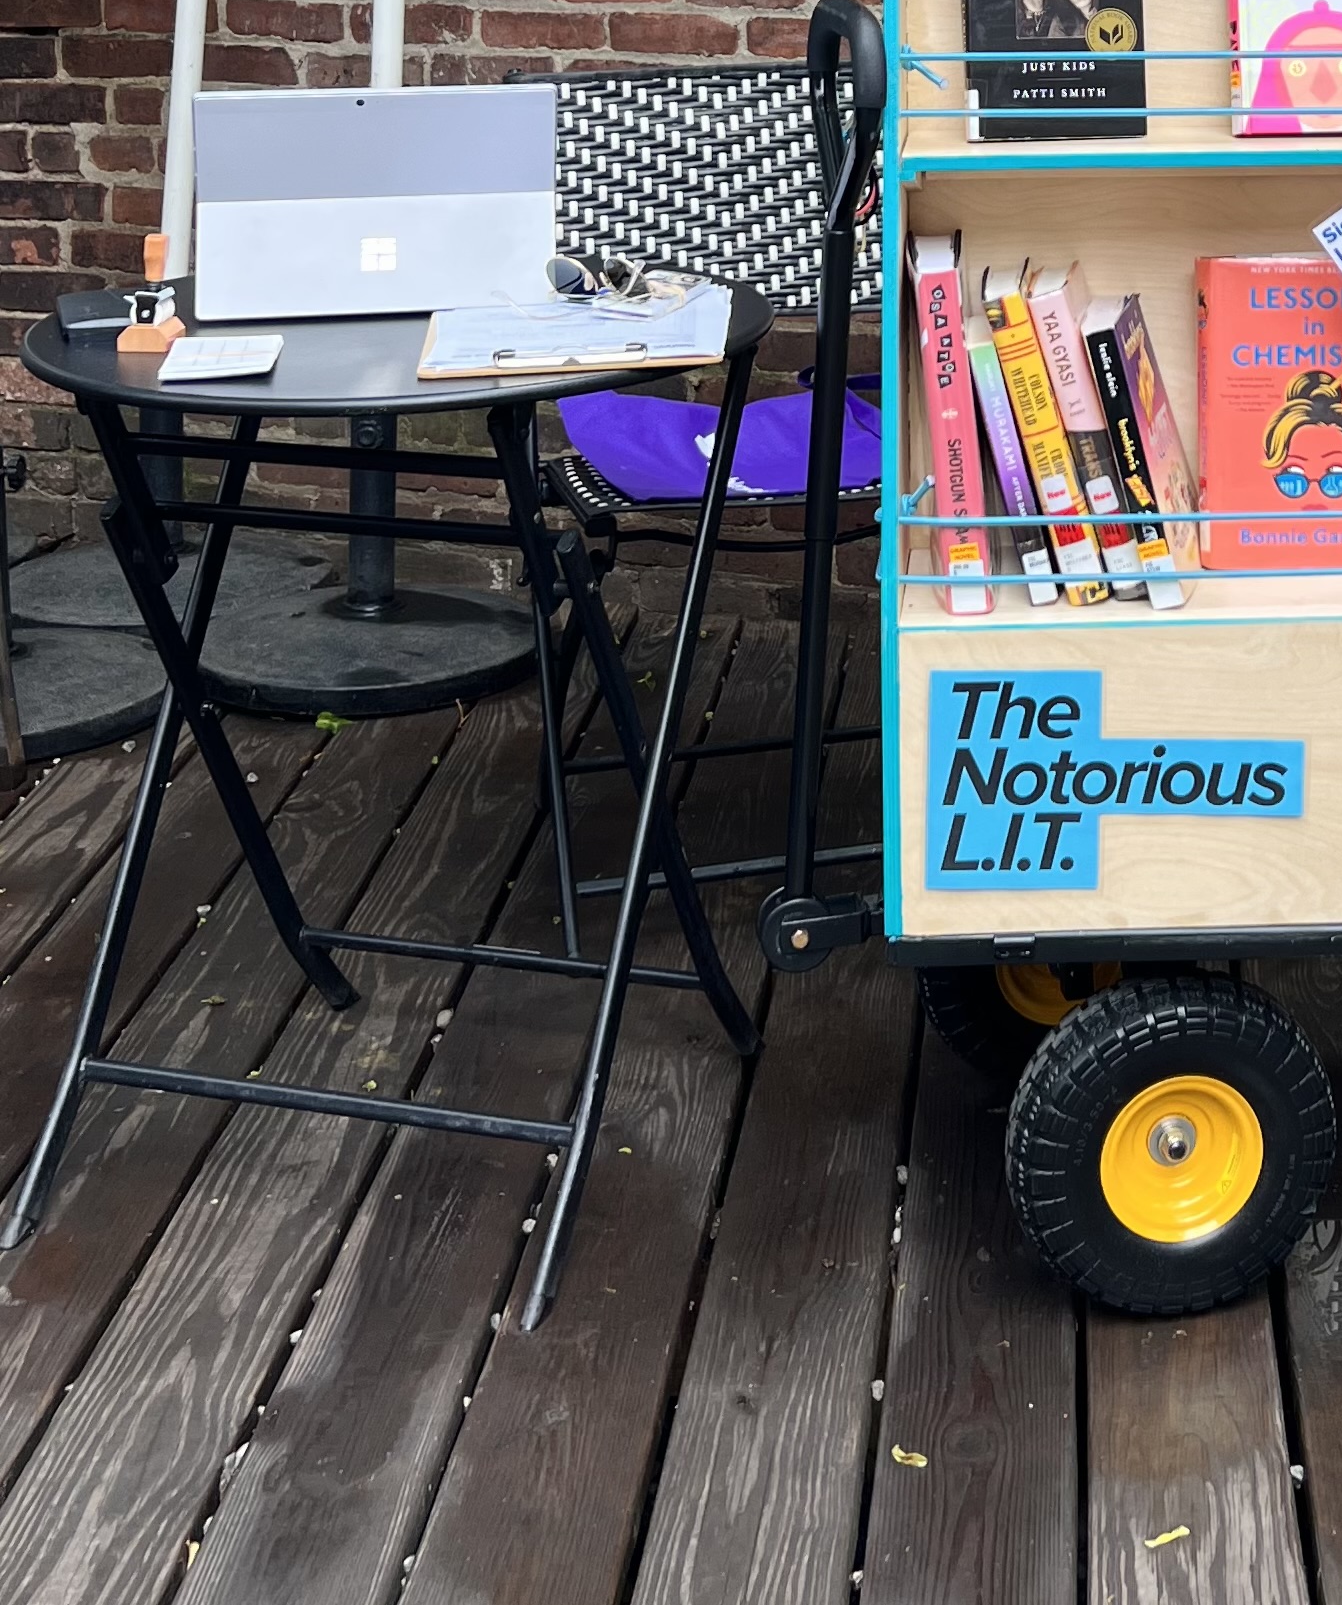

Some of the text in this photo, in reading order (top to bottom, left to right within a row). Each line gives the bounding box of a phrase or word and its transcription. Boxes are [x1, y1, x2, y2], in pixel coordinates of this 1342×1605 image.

[1013, 87, 1106, 98] PATTI SMITH
[1022, 61, 1096, 73] JUST KIDS
[1042, 310, 1077, 388] YAA GYASI
[1304, 317, 1325, 334] in
[1010, 367, 1038, 427] WHITEHEAD
[948, 438, 966, 503] SHOTGUN
[991, 397, 1018, 471] MURAKAMI
[1011, 476, 1023, 501] AFTER
[1046, 489, 1066, 500] New
[1093, 491, 1112, 502] New
[1240, 528, 1307, 545] Bonnie
[953, 681, 1081, 739] The
[943, 745, 1288, 805] Notorious
[941, 812, 1082, 871] L.I.T.
